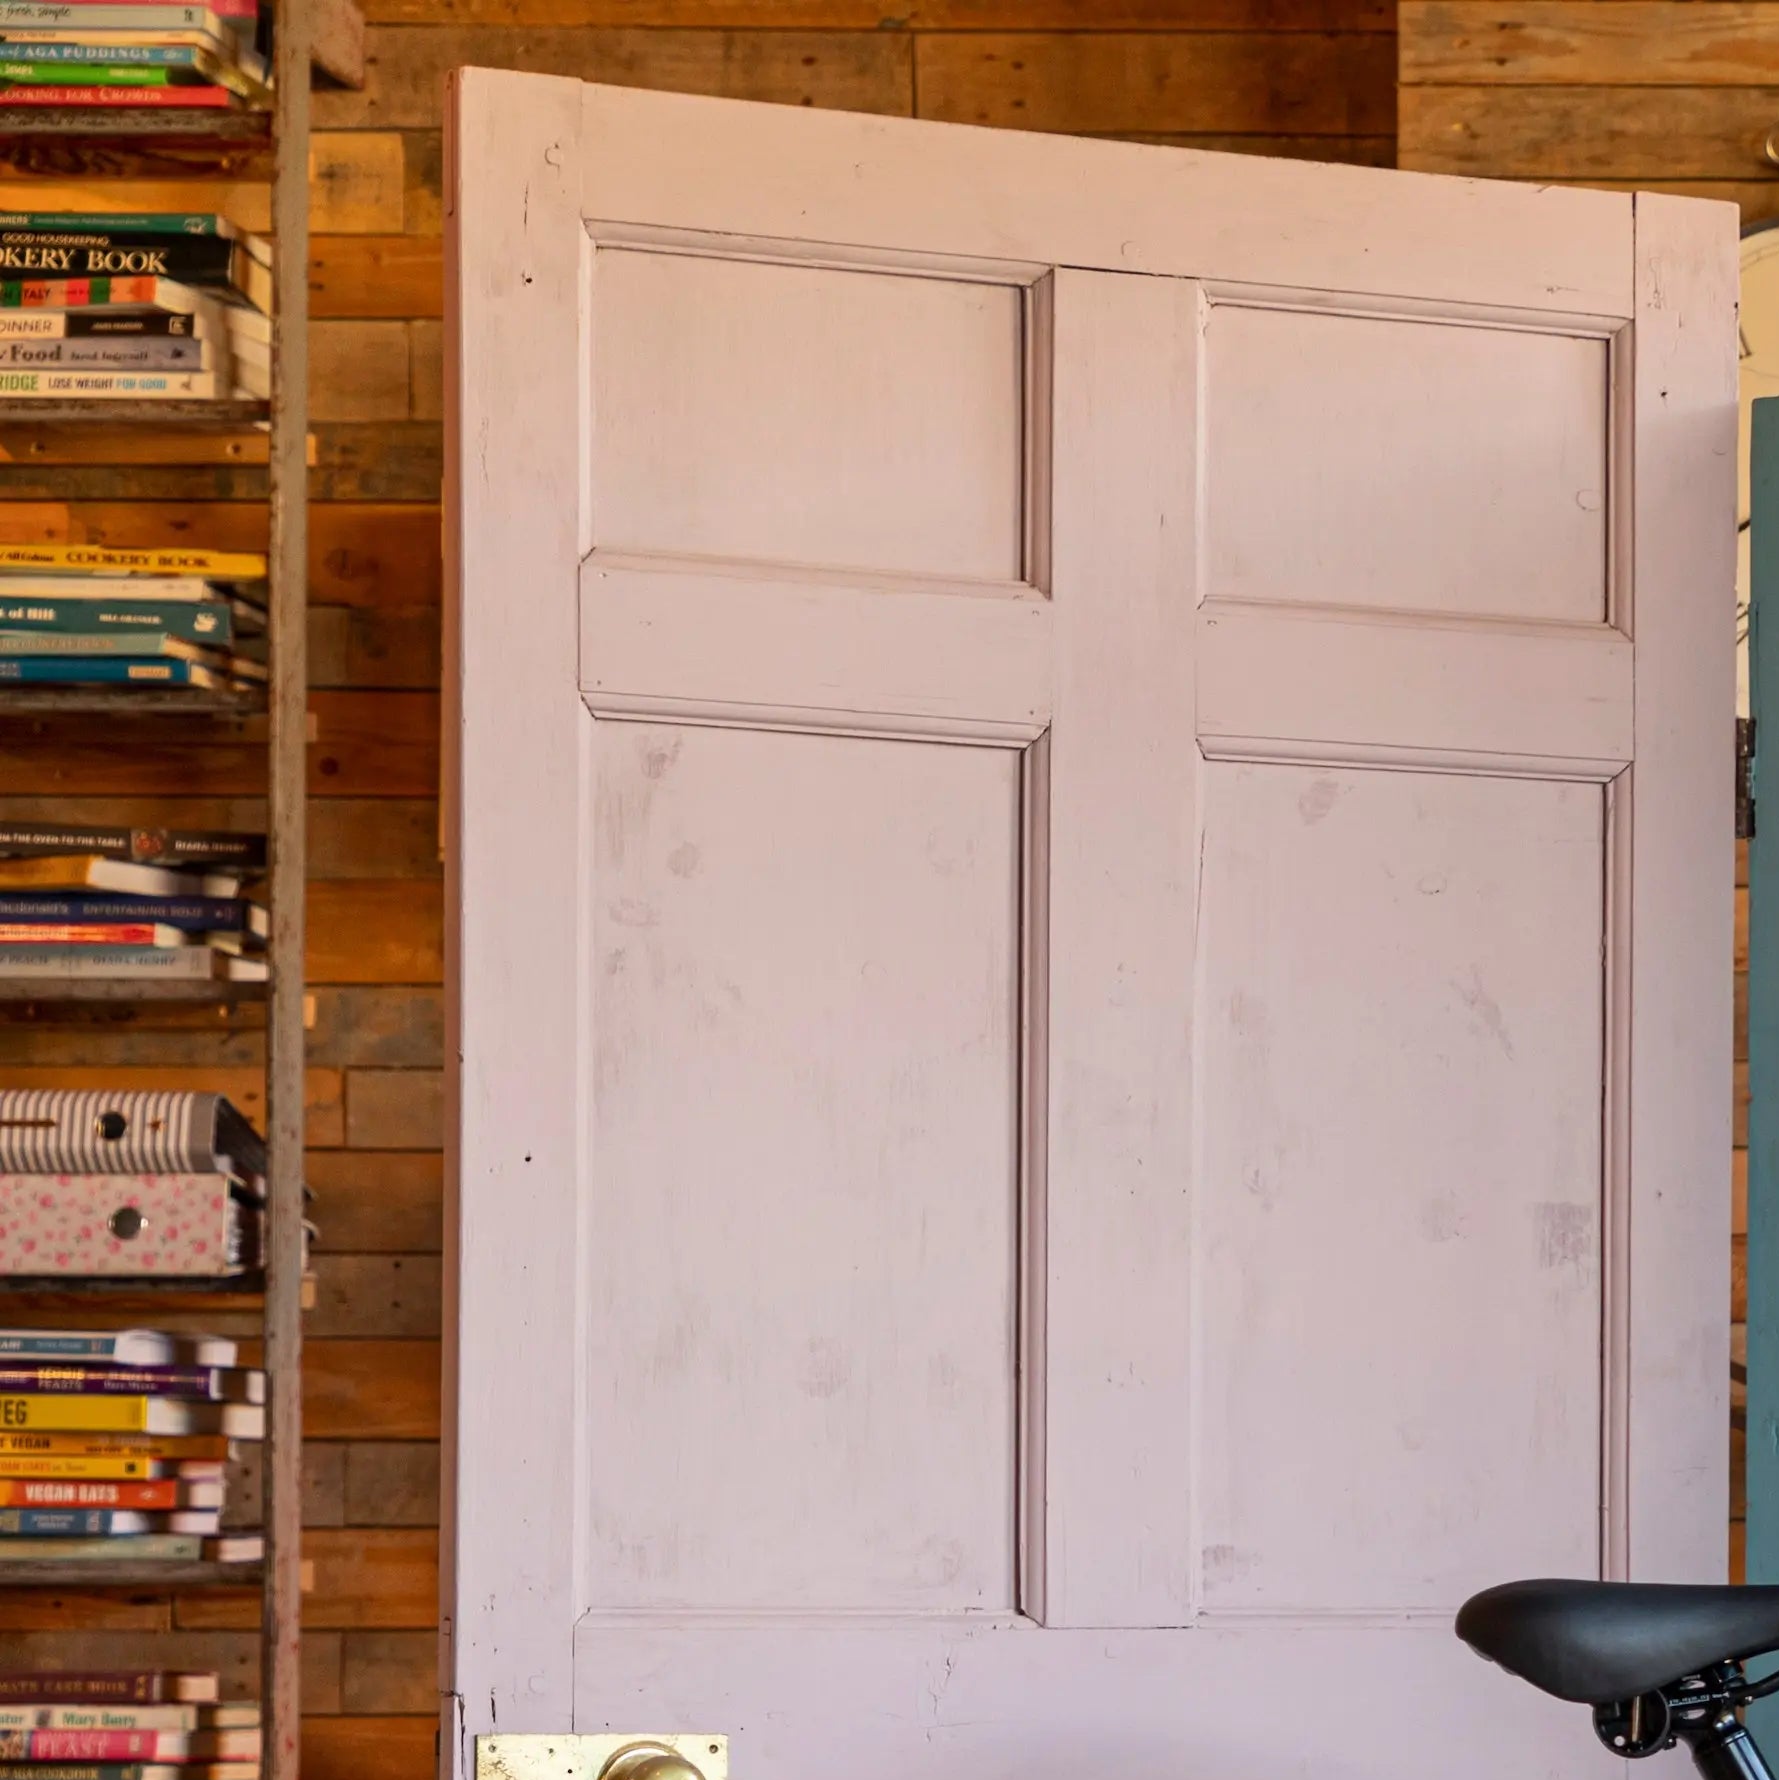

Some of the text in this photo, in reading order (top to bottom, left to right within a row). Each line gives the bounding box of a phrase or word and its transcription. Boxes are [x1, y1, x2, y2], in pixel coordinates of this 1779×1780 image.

[62, 47, 150, 59] PUDDINGS
[2, 231, 110, 247] GOOD HOUSEKEEPING
[0, 247, 168, 274] KERY BOOK
[11, 344, 62, 362] Food
